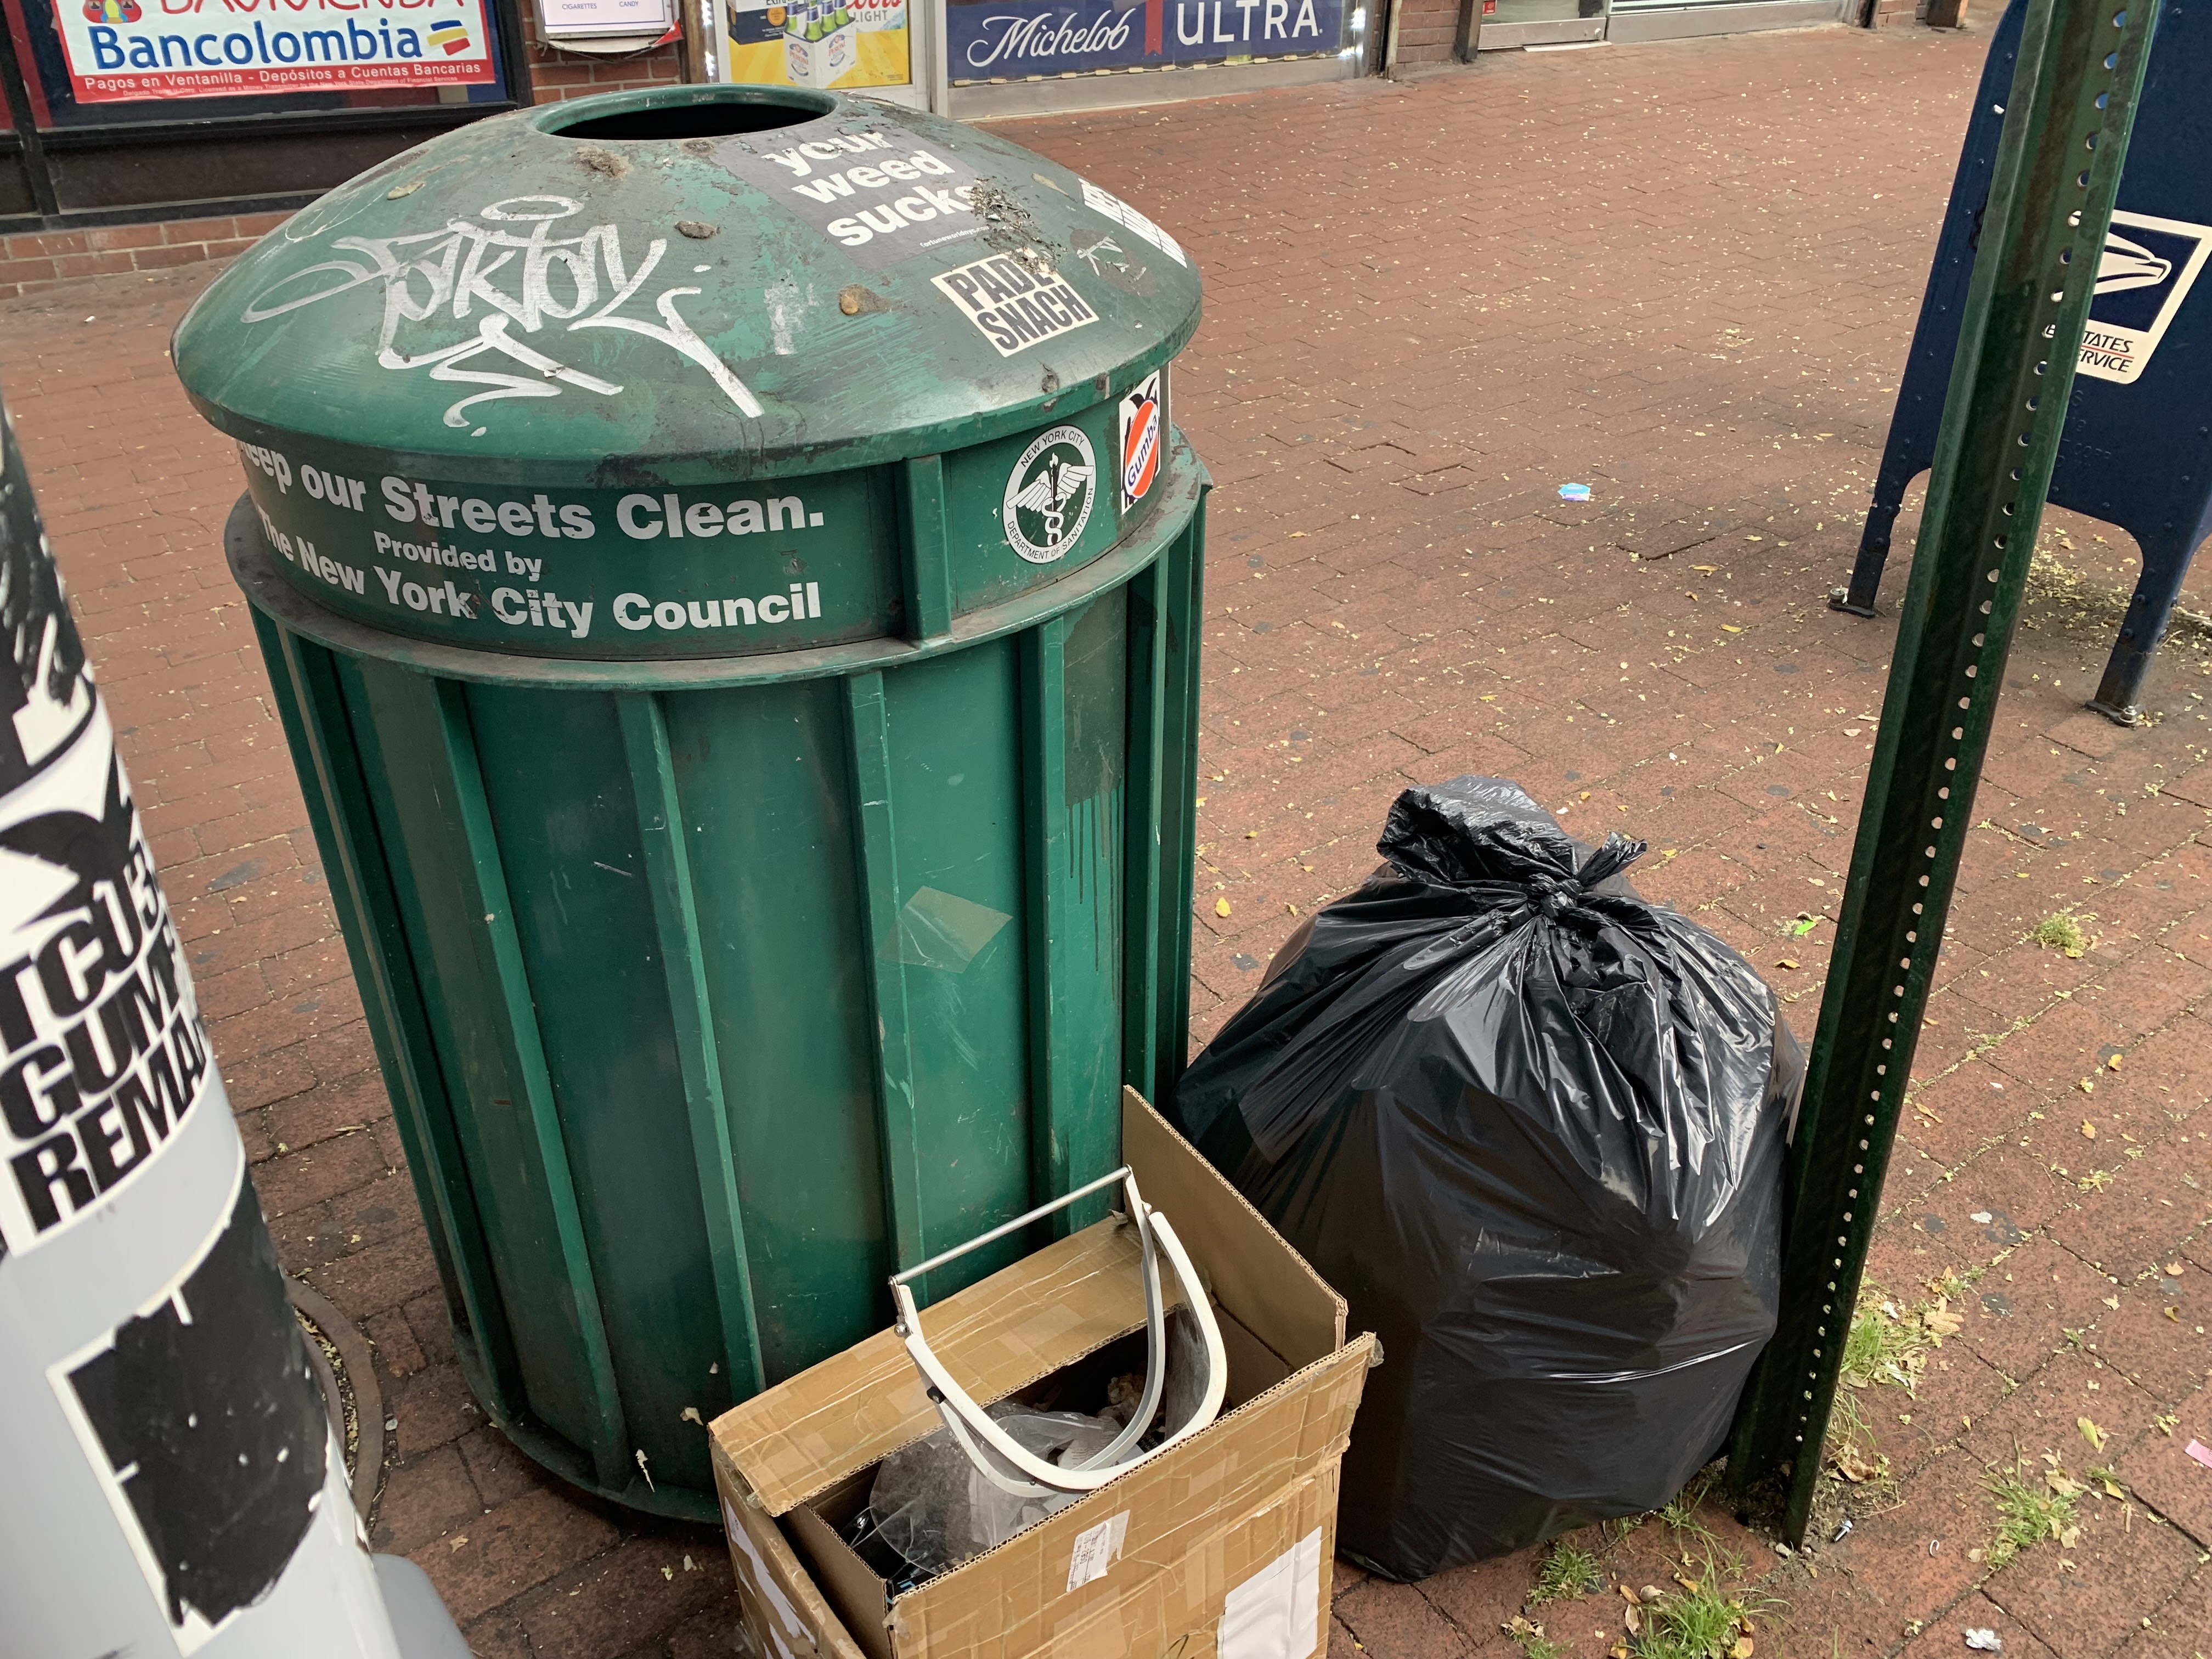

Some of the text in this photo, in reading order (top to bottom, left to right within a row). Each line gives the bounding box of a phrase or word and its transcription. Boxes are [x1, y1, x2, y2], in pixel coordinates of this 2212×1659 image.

[854, 10, 887, 22] LIGHT
[967, 0, 1319, 67] Michelob ULTRA
[87, 18, 422, 70] Bancolombia
[84, 77, 136, 91] Pagos
[141, 77, 160, 87] en
[165, 72, 242, 86] Ventanilla
[259, 66, 331, 83] Depósitos
[337, 69, 346, 78] a
[351, 65, 409, 78] Cuentas
[414, 62, 481, 75] Bancarias
[761, 132, 893, 177] your
[791, 150, 955, 204] weed
[977, 284, 1093, 350] SNACH
[2083, 331, 2134, 353] TATES
[2079, 349, 2134, 373] RVICE
[1020, 430, 1085, 468] NEW YORK CITY
[1127, 414, 1158, 487] Gumba
[239, 442, 824, 539] eep our Streets Clean.
[1007, 487, 1093, 560] DEPARTMENT OF SANITATION
[258, 504, 822, 639] The New York City Council
[374, 531, 542, 582] Provided by
